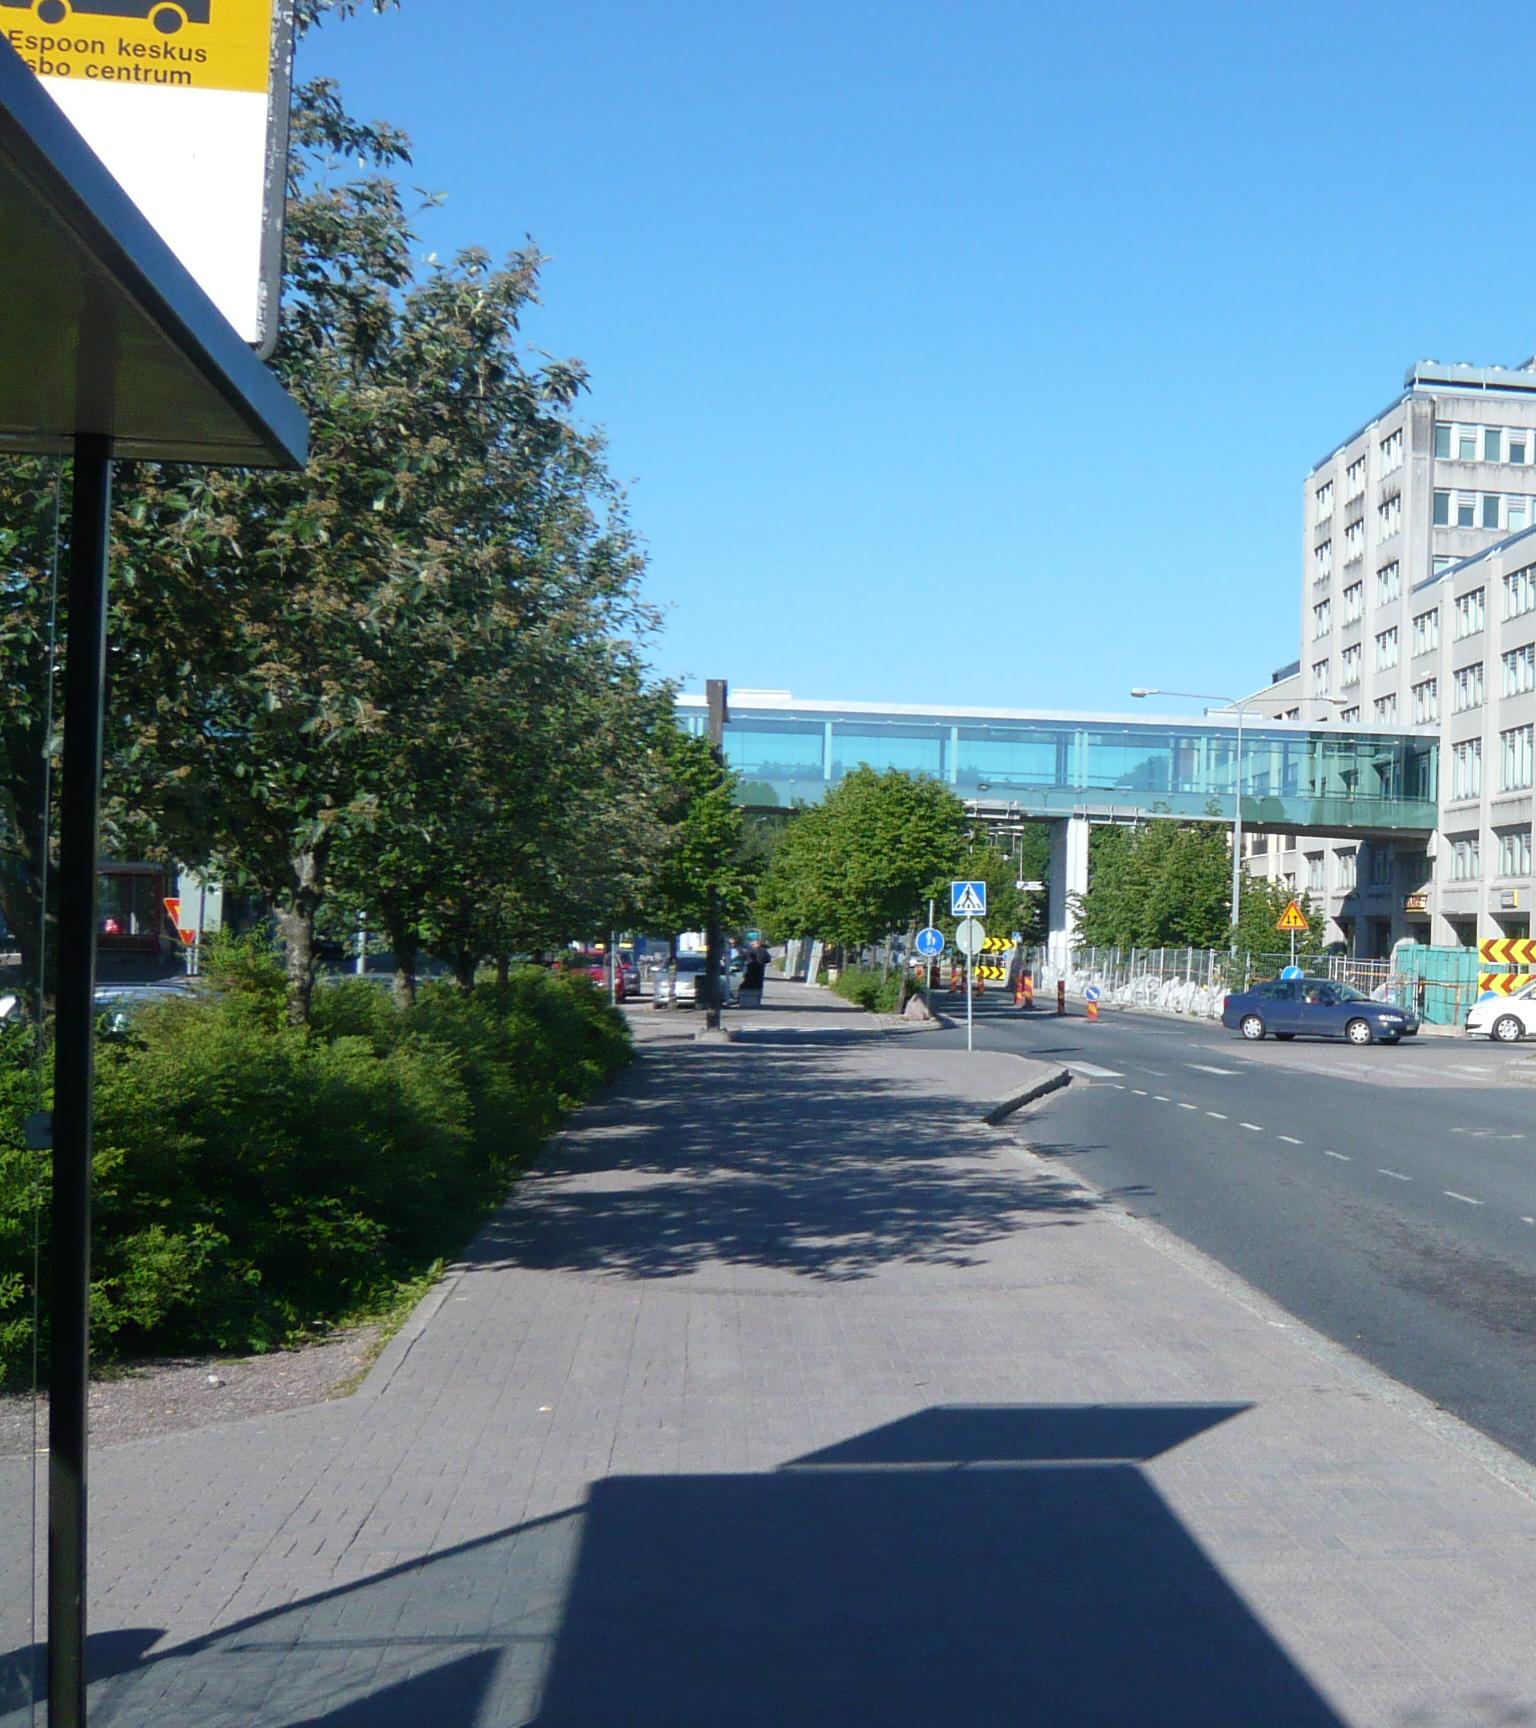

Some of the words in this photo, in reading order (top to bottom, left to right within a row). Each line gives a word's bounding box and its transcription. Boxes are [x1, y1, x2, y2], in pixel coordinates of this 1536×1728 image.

[8, 29, 105, 54] Espoon
[117, 37, 208, 63] keskus
[20, 55, 71, 76] sbo
[84, 63, 192, 85] centrum
